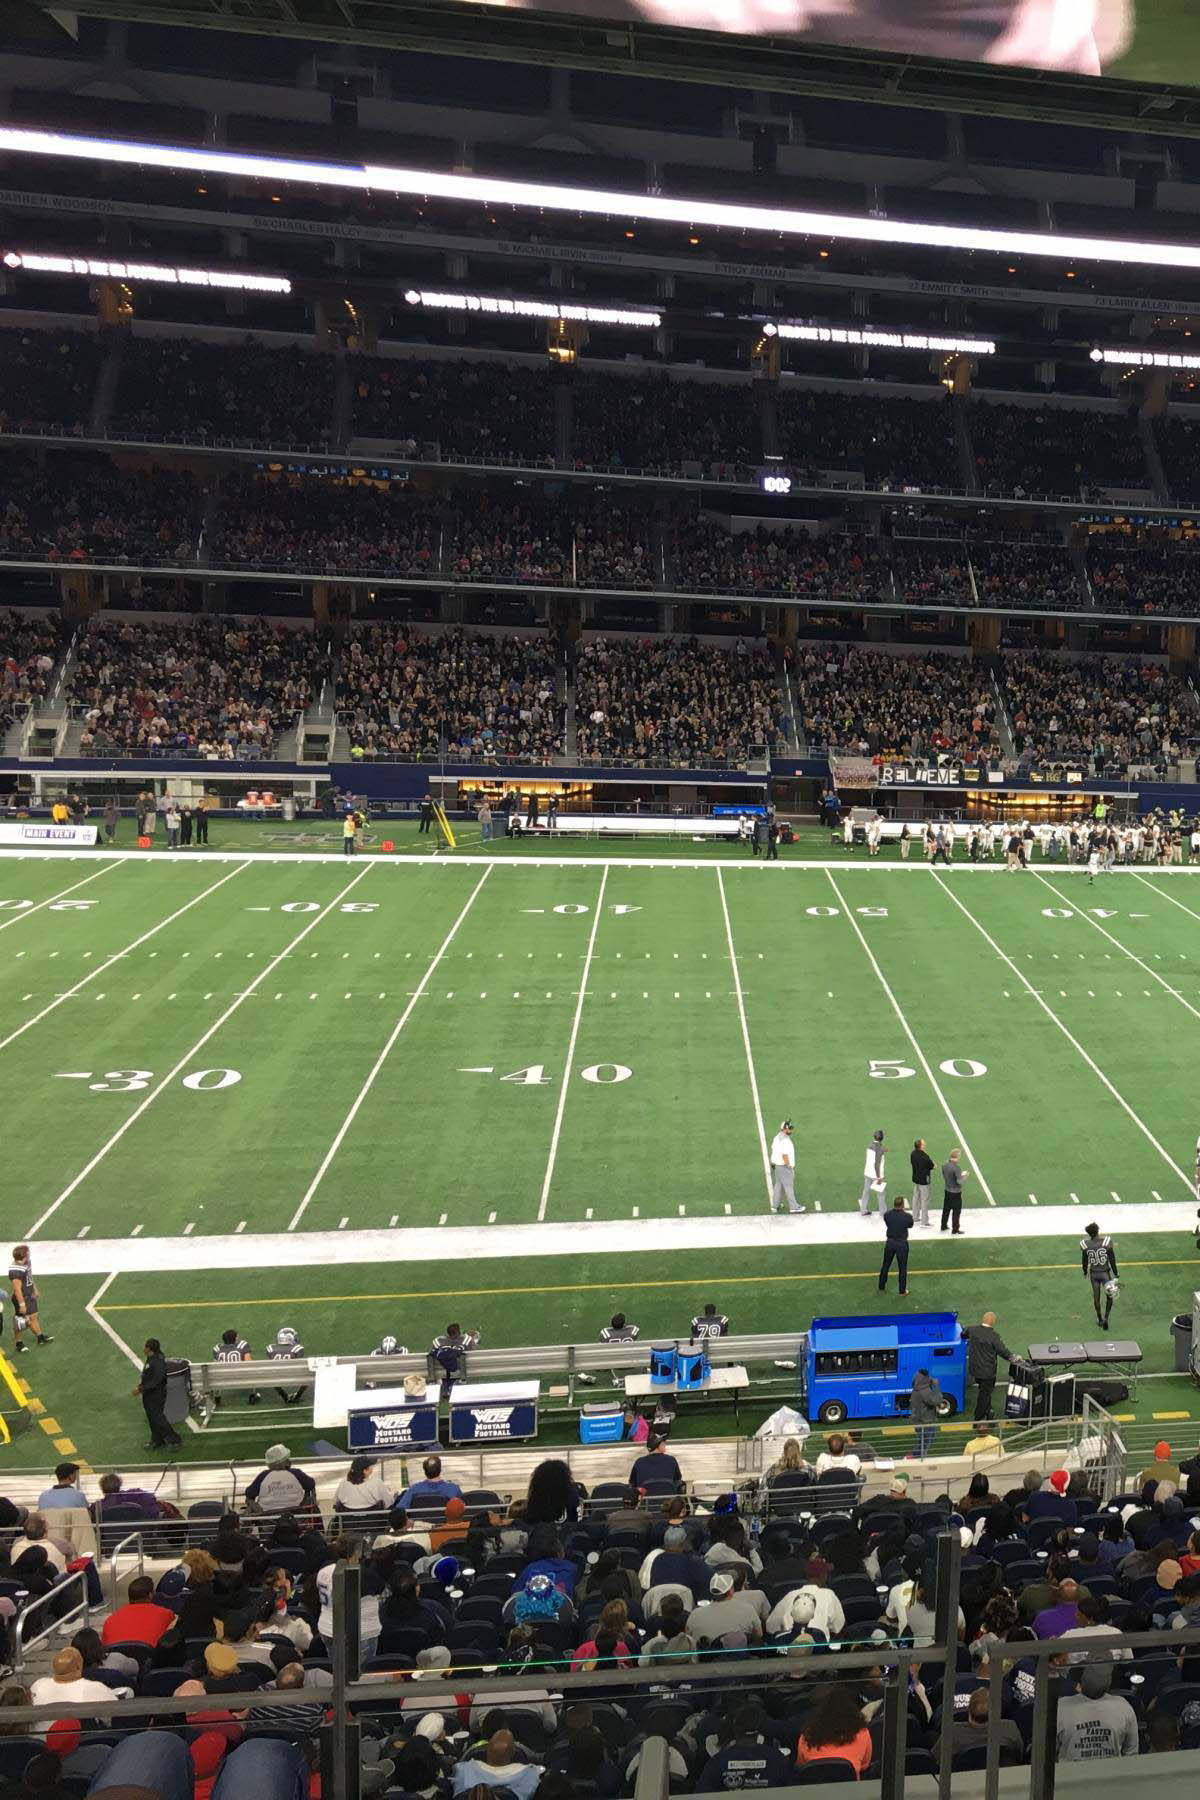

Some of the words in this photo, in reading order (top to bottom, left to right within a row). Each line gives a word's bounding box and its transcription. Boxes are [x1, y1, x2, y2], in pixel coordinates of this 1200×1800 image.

[499, 1063, 633, 1086] 40
[867, 1058, 988, 1080] 50
[88, 1068, 242, 1092] 30
[697, 1324, 721, 1338] 79
[375, 1429, 412, 1437] MUSTANG
[474, 1429, 511, 1437] FOOTBALL
[374, 1436, 412, 1444] FOOTBALL
[1086, 1728, 1112, 1736] FASTER
